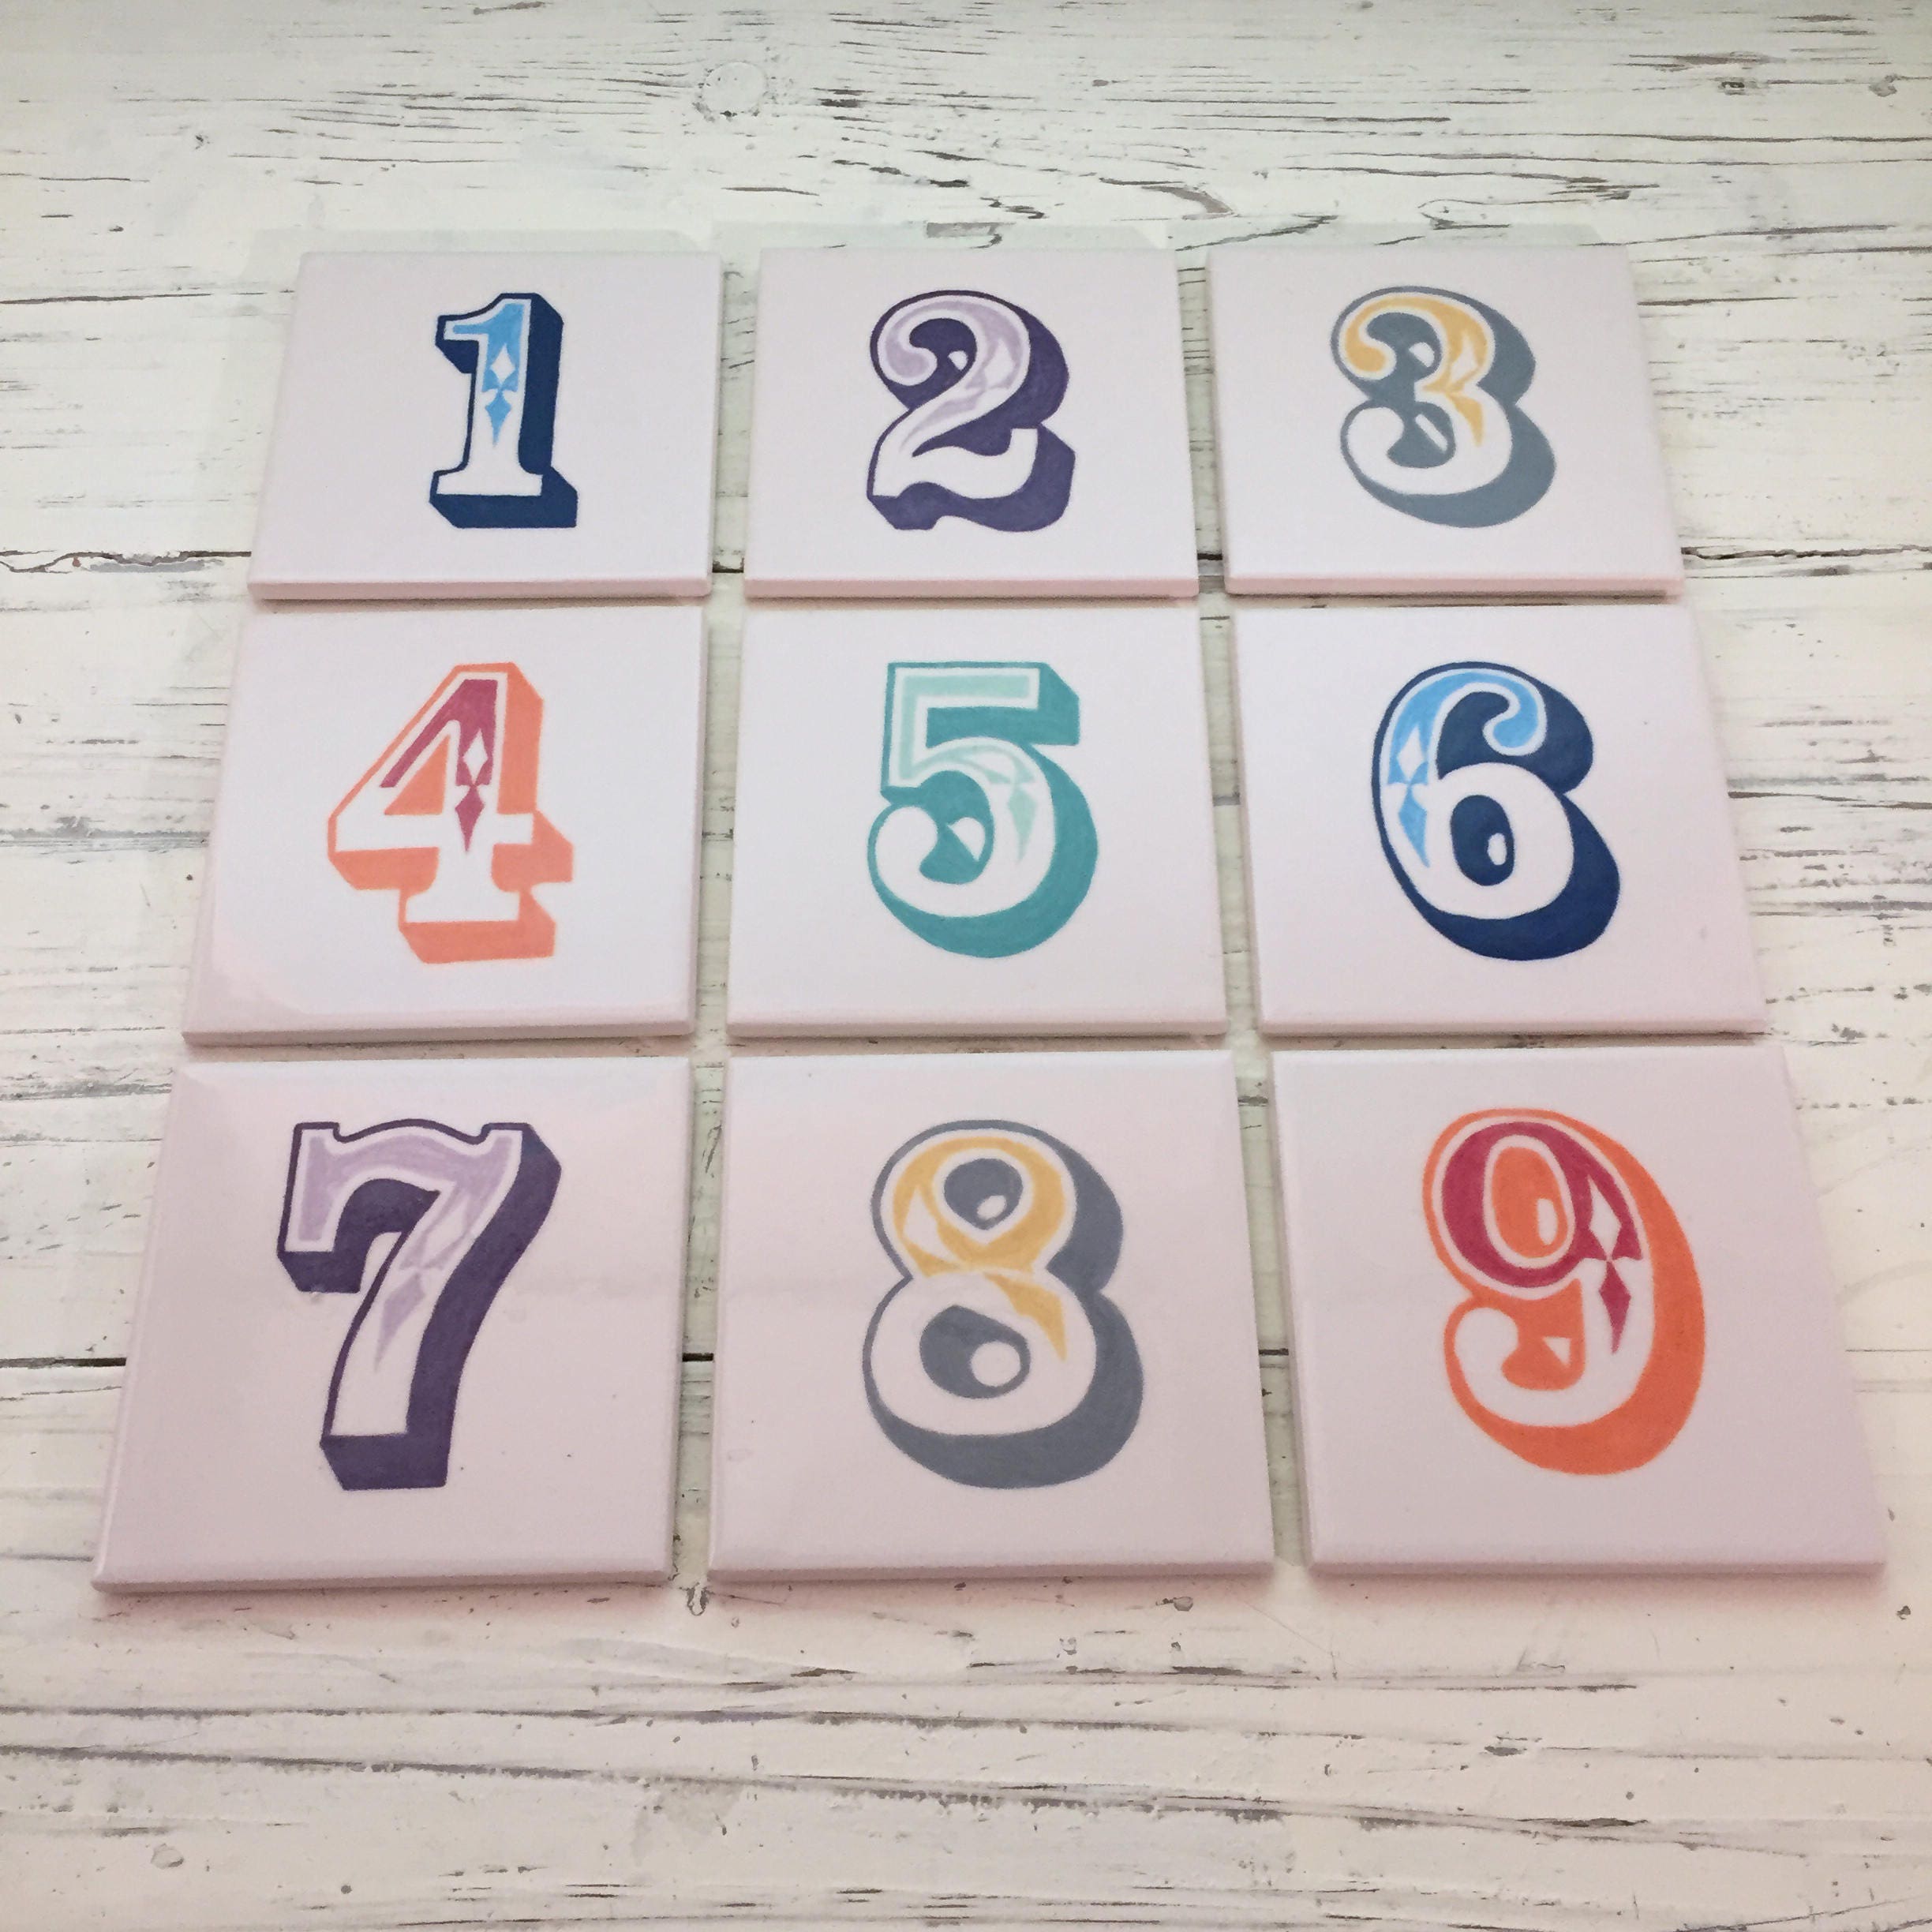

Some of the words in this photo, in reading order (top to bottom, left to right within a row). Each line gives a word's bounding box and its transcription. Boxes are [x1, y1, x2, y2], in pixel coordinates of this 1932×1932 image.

[429, 292, 578, 529] 1
[867, 290, 1076, 533] 2
[1330, 286, 1556, 528] 3
[328, 662, 572, 964] 4
[867, 659, 1098, 958] 5
[1371, 660, 1620, 961] 6
[276, 1118, 562, 1492] 7
[862, 1120, 1144, 1490] 8
[1423, 1109, 1705, 1475] 9
